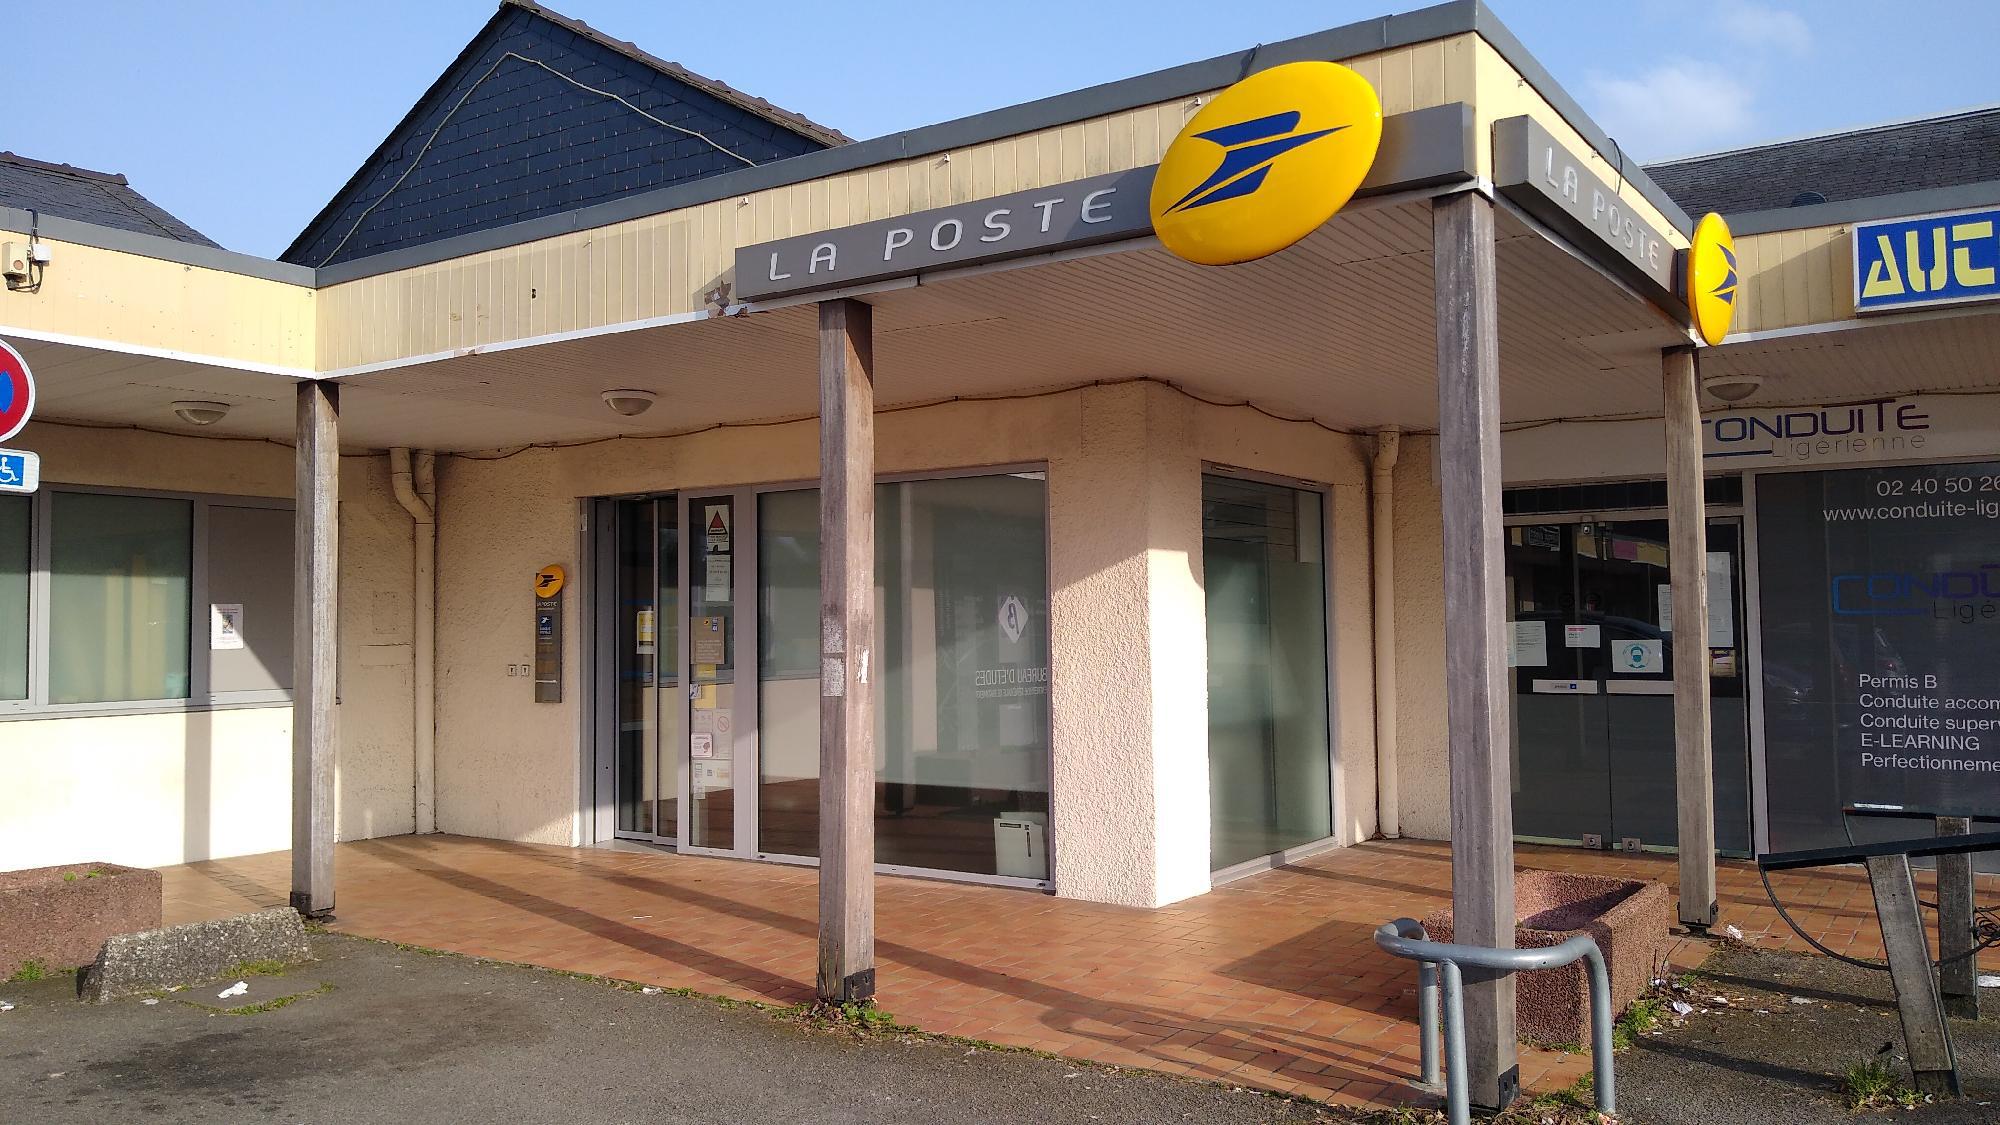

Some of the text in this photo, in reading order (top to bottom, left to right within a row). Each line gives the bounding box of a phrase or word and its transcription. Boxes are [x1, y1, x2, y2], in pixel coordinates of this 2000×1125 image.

[1545, 146, 1660, 271] LA POSTE
[768, 187, 1118, 282] LA POSTE
[1876, 480, 1904, 497] 02
[1910, 479, 1938, 494] 40
[1944, 477, 1973, 493] 50
[1823, 500, 1999, 521] www.conduite-lig
[1859, 673, 1937, 689] Permis B
[1859, 693, 1940, 709] Conduite
[1860, 712, 2000, 733] Conduite super
[1861, 733, 1980, 751] E-LEARNING
[1861, 752, 2000, 771] Perfectionneme
